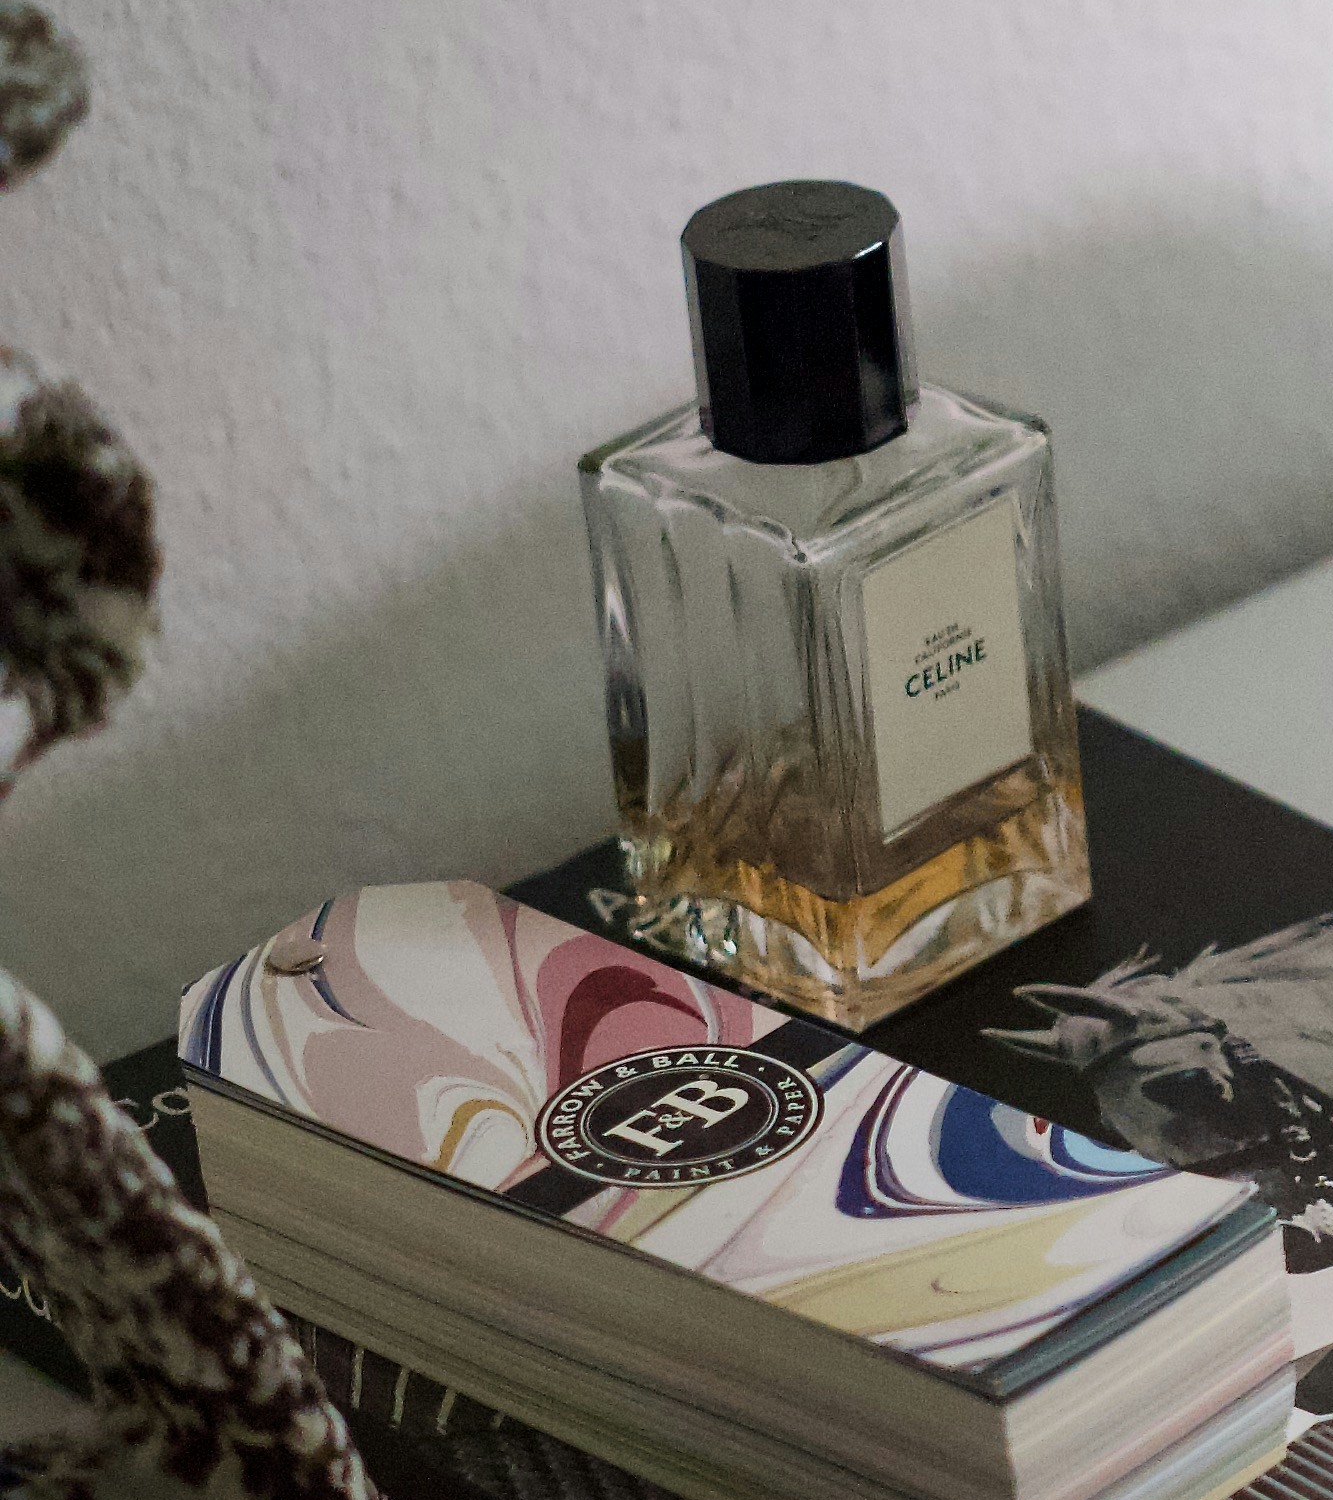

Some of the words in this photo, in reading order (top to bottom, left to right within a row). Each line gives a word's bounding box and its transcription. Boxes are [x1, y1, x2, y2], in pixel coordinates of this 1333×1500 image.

[905, 638, 987, 697] CELINE
[552, 1079, 604, 1161] FARROW
[615, 1064, 638, 1078] &
[652, 1053, 739, 1068] BALL
[624, 1158, 735, 1180] PAINT
[755, 1144, 775, 1156] &
[774, 1076, 805, 1136] PAPER
